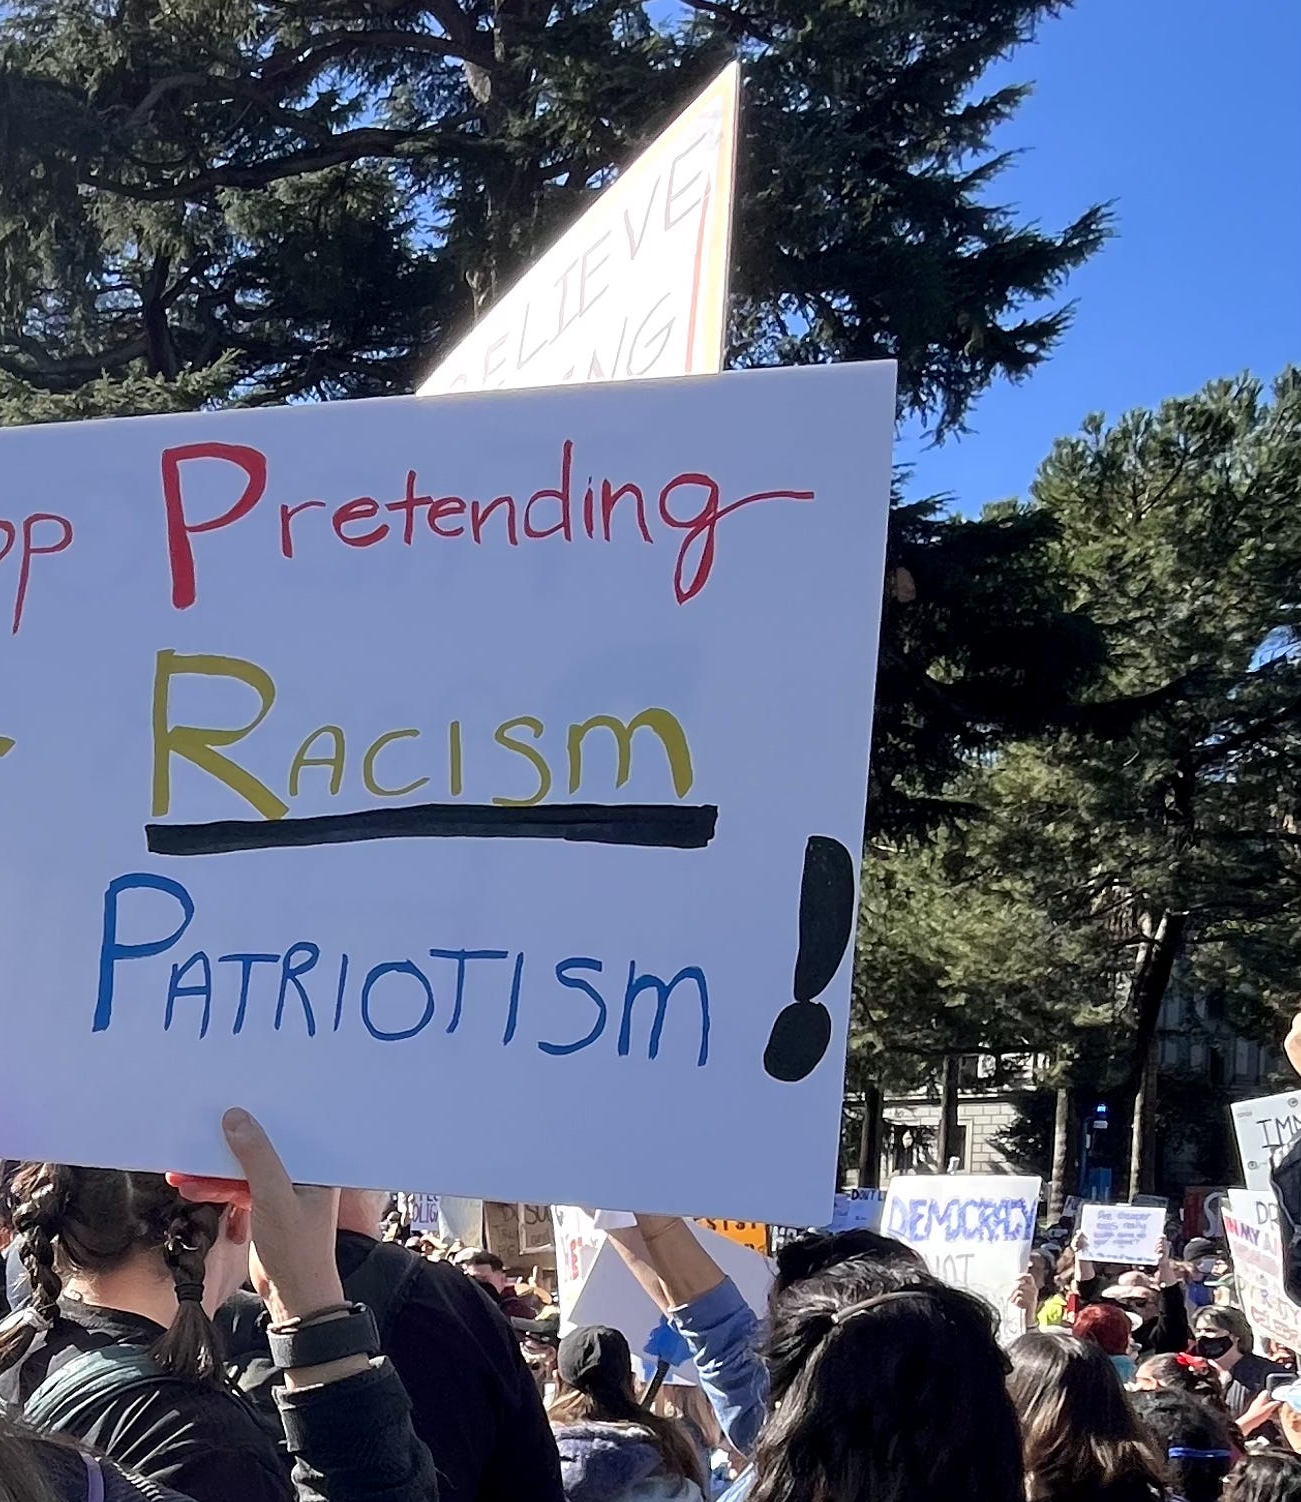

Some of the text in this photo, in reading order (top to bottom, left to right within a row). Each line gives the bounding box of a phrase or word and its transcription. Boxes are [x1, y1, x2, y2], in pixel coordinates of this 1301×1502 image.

[450, 131, 708, 387] ELIEVE
[162, 441, 814, 608] Pretending
[888, 1195, 1036, 1242] DEMOCRACY
